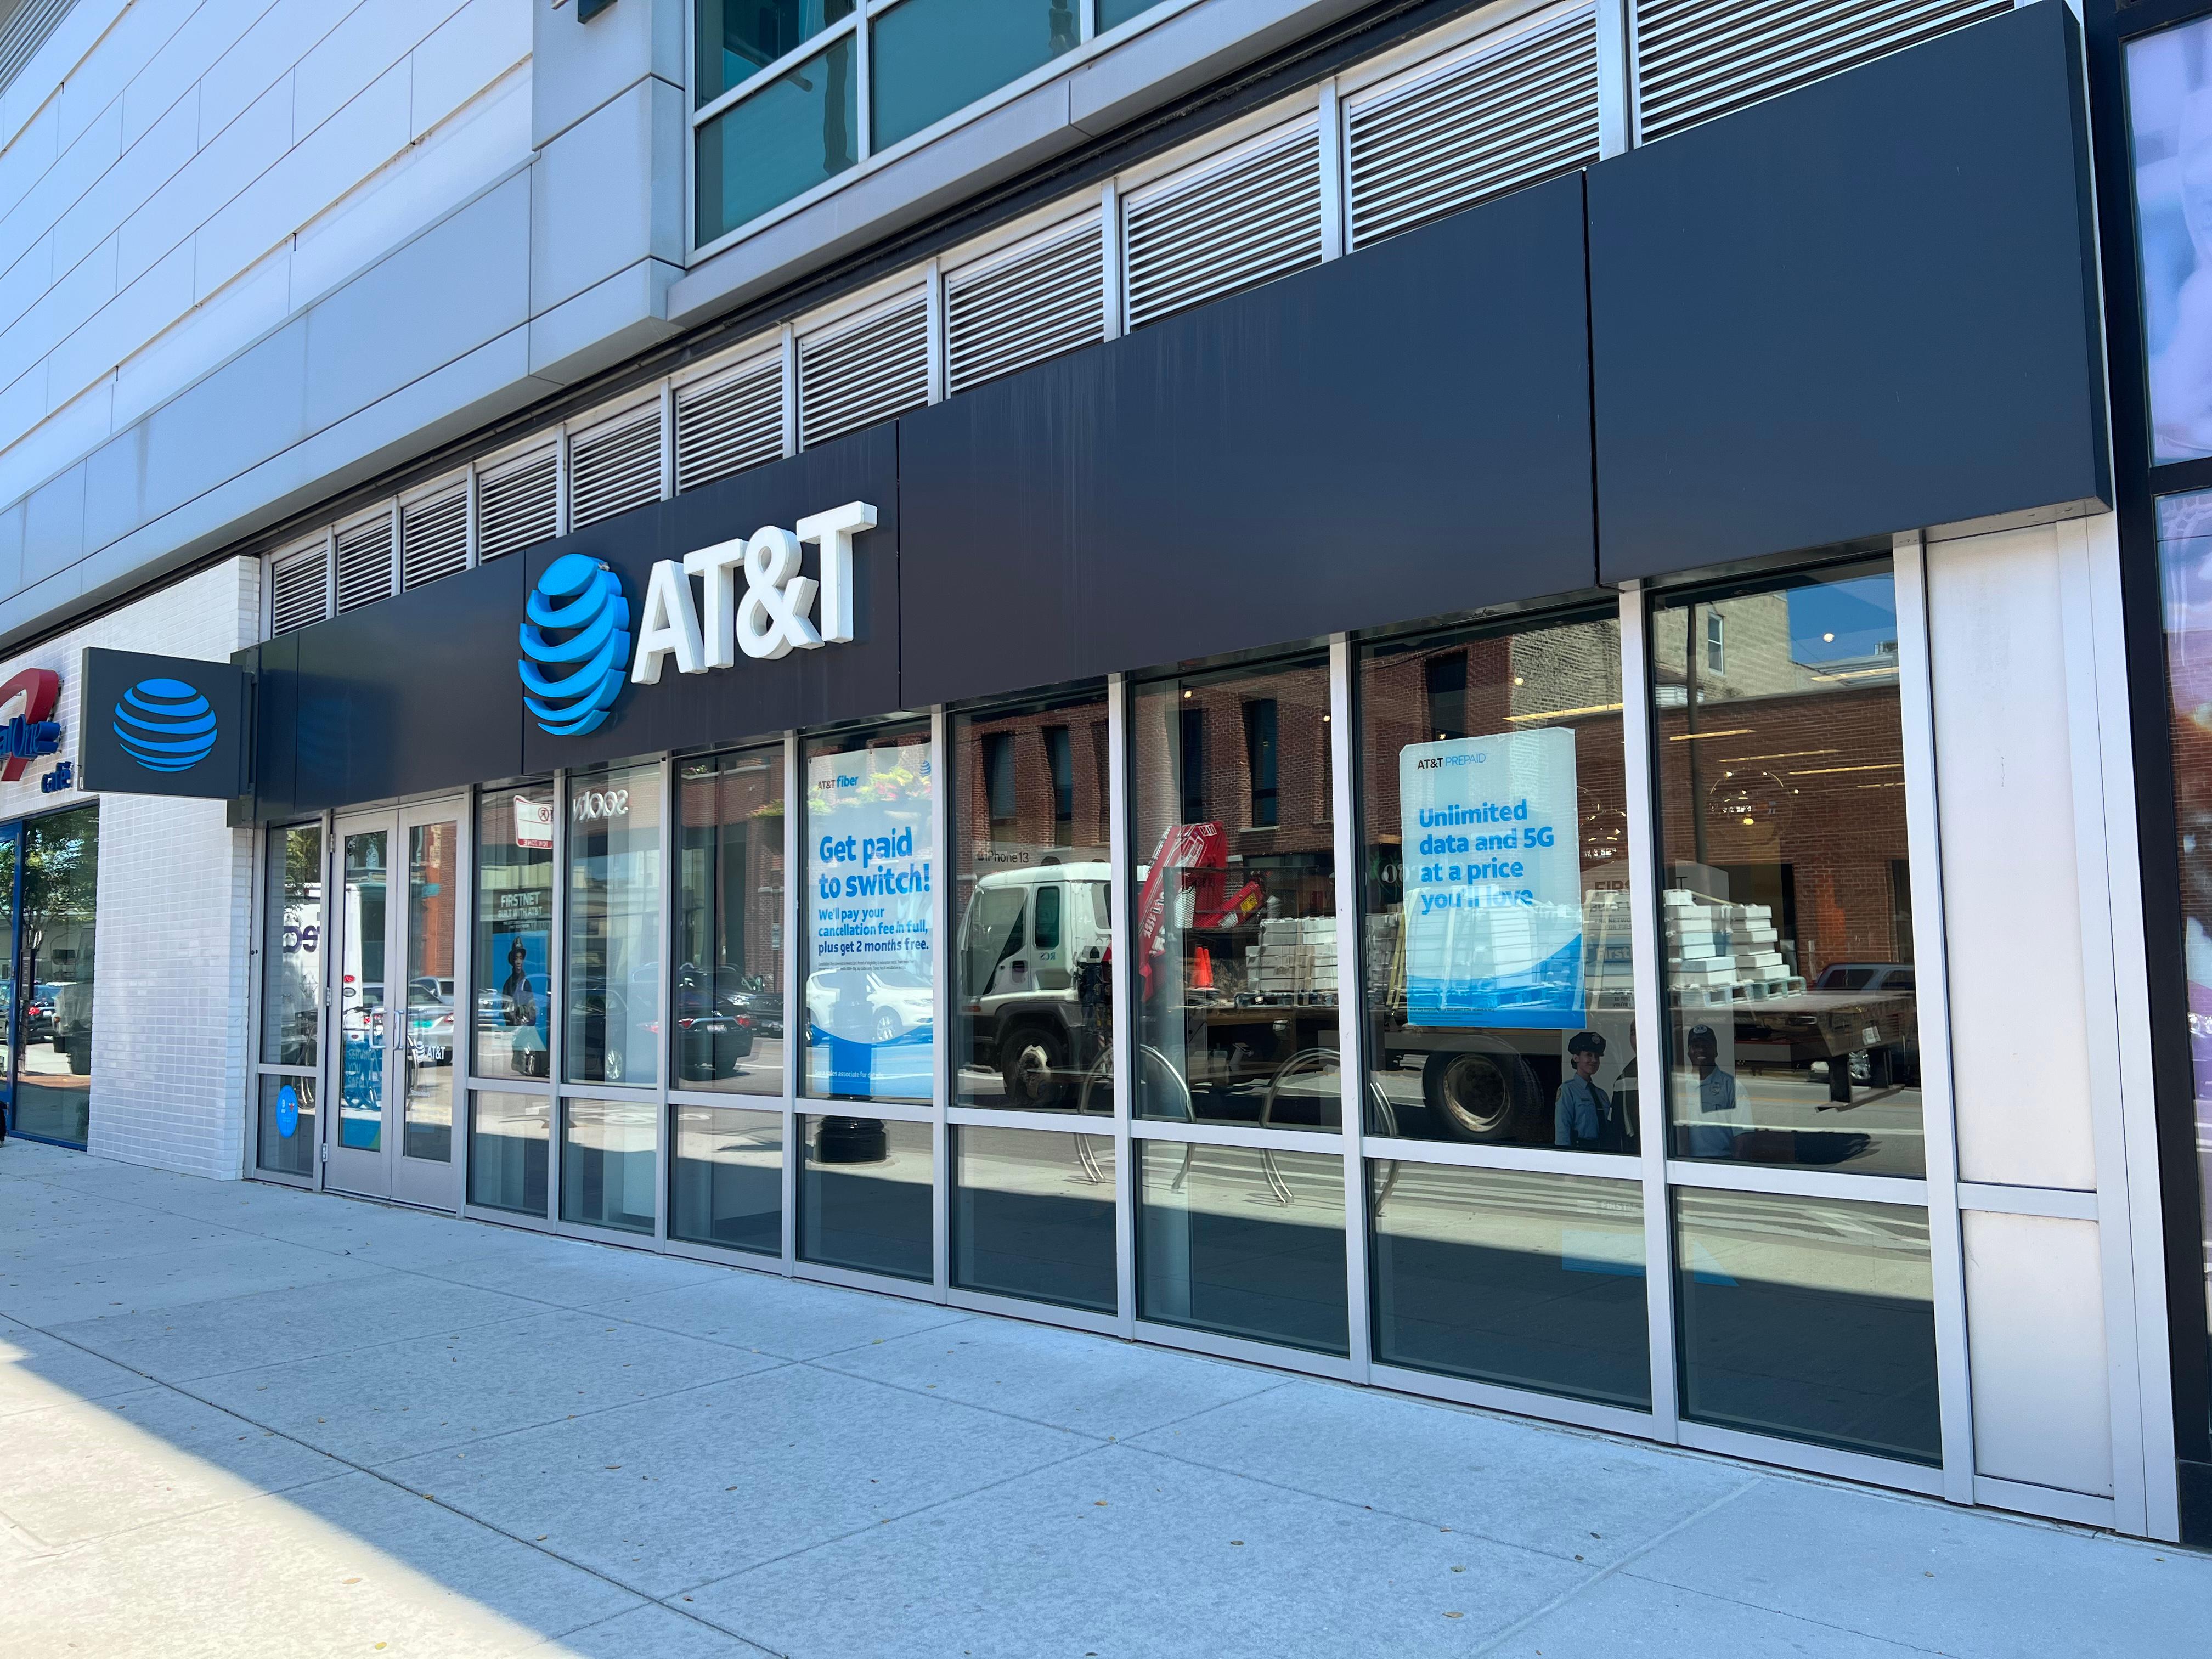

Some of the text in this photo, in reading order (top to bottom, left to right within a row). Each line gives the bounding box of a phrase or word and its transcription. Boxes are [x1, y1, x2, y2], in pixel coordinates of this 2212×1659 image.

[630, 500, 878, 685] AT&T
[1417, 753, 1486, 770] AT&T PREPAID
[817, 775, 859, 791] AT&T fiber
[1419, 799, 1528, 828] Unlimited
[820, 826, 913, 868] Get paid
[1419, 826, 1554, 855] data and 5G
[985, 850, 1029, 863] iPhone 13
[818, 862, 930, 899] to switch!
[1421, 863, 1443, 883] at
[1448, 865, 1462, 881] a
[1467, 857, 1523, 885] price
[501, 891, 541, 908] FIRSTNET
[1486, 885, 1533, 906] love
[819, 907, 885, 923] We'll pay your
[819, 919, 928, 937] cancellation fee in full,
[819, 937, 929, 957] plus get 2 months free.
[427, 1045, 446, 1060] AT&T
[348, 1062, 362, 1074] YOU
